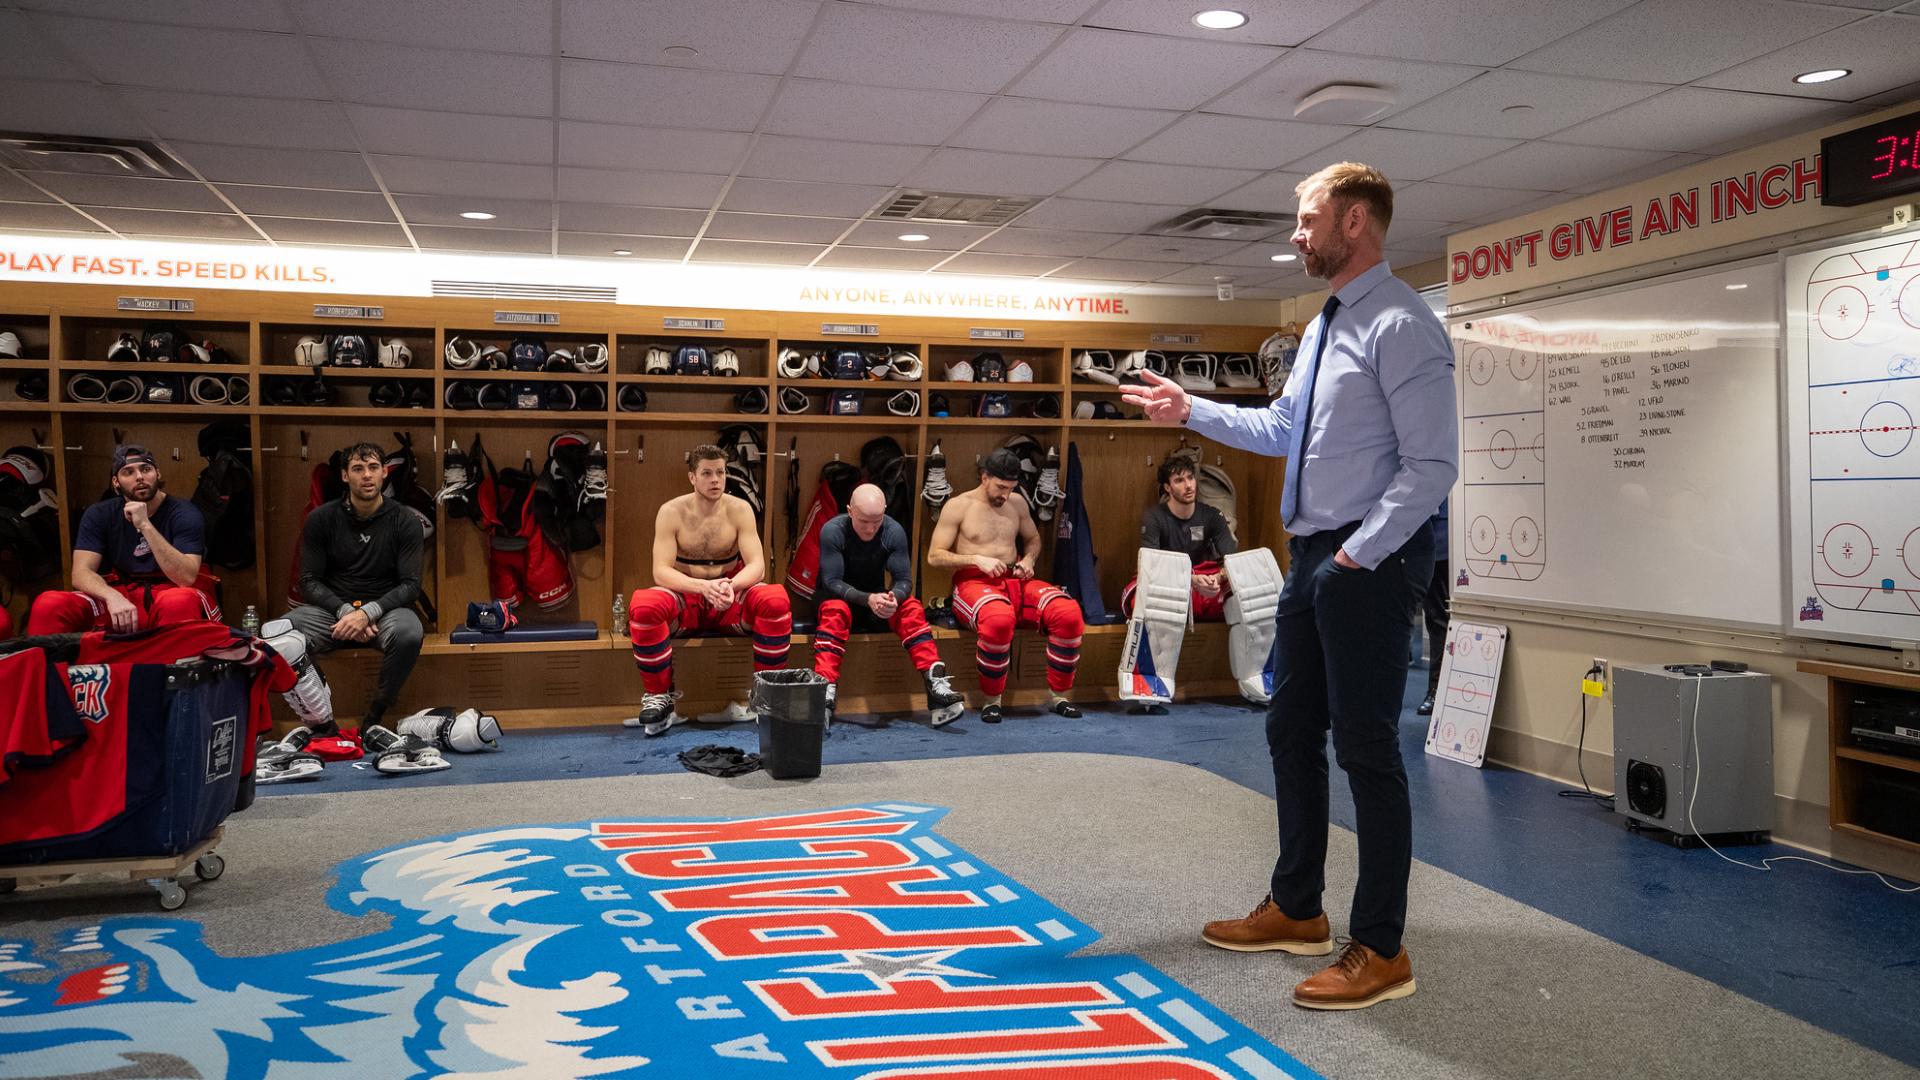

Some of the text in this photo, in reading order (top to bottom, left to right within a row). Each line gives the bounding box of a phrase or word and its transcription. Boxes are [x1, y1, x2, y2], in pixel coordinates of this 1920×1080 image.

[1451, 154, 1822, 285] DON'T GIVE AN INCH
[72, 256, 149, 276] FAST.
[157, 260, 246, 279] SPEED
[255, 264, 335, 283] KILLS.
[1034, 296, 1129, 315] ANYTIME.
[847, 359, 853, 369] 2
[1127, 621, 1142, 669] TRUE
